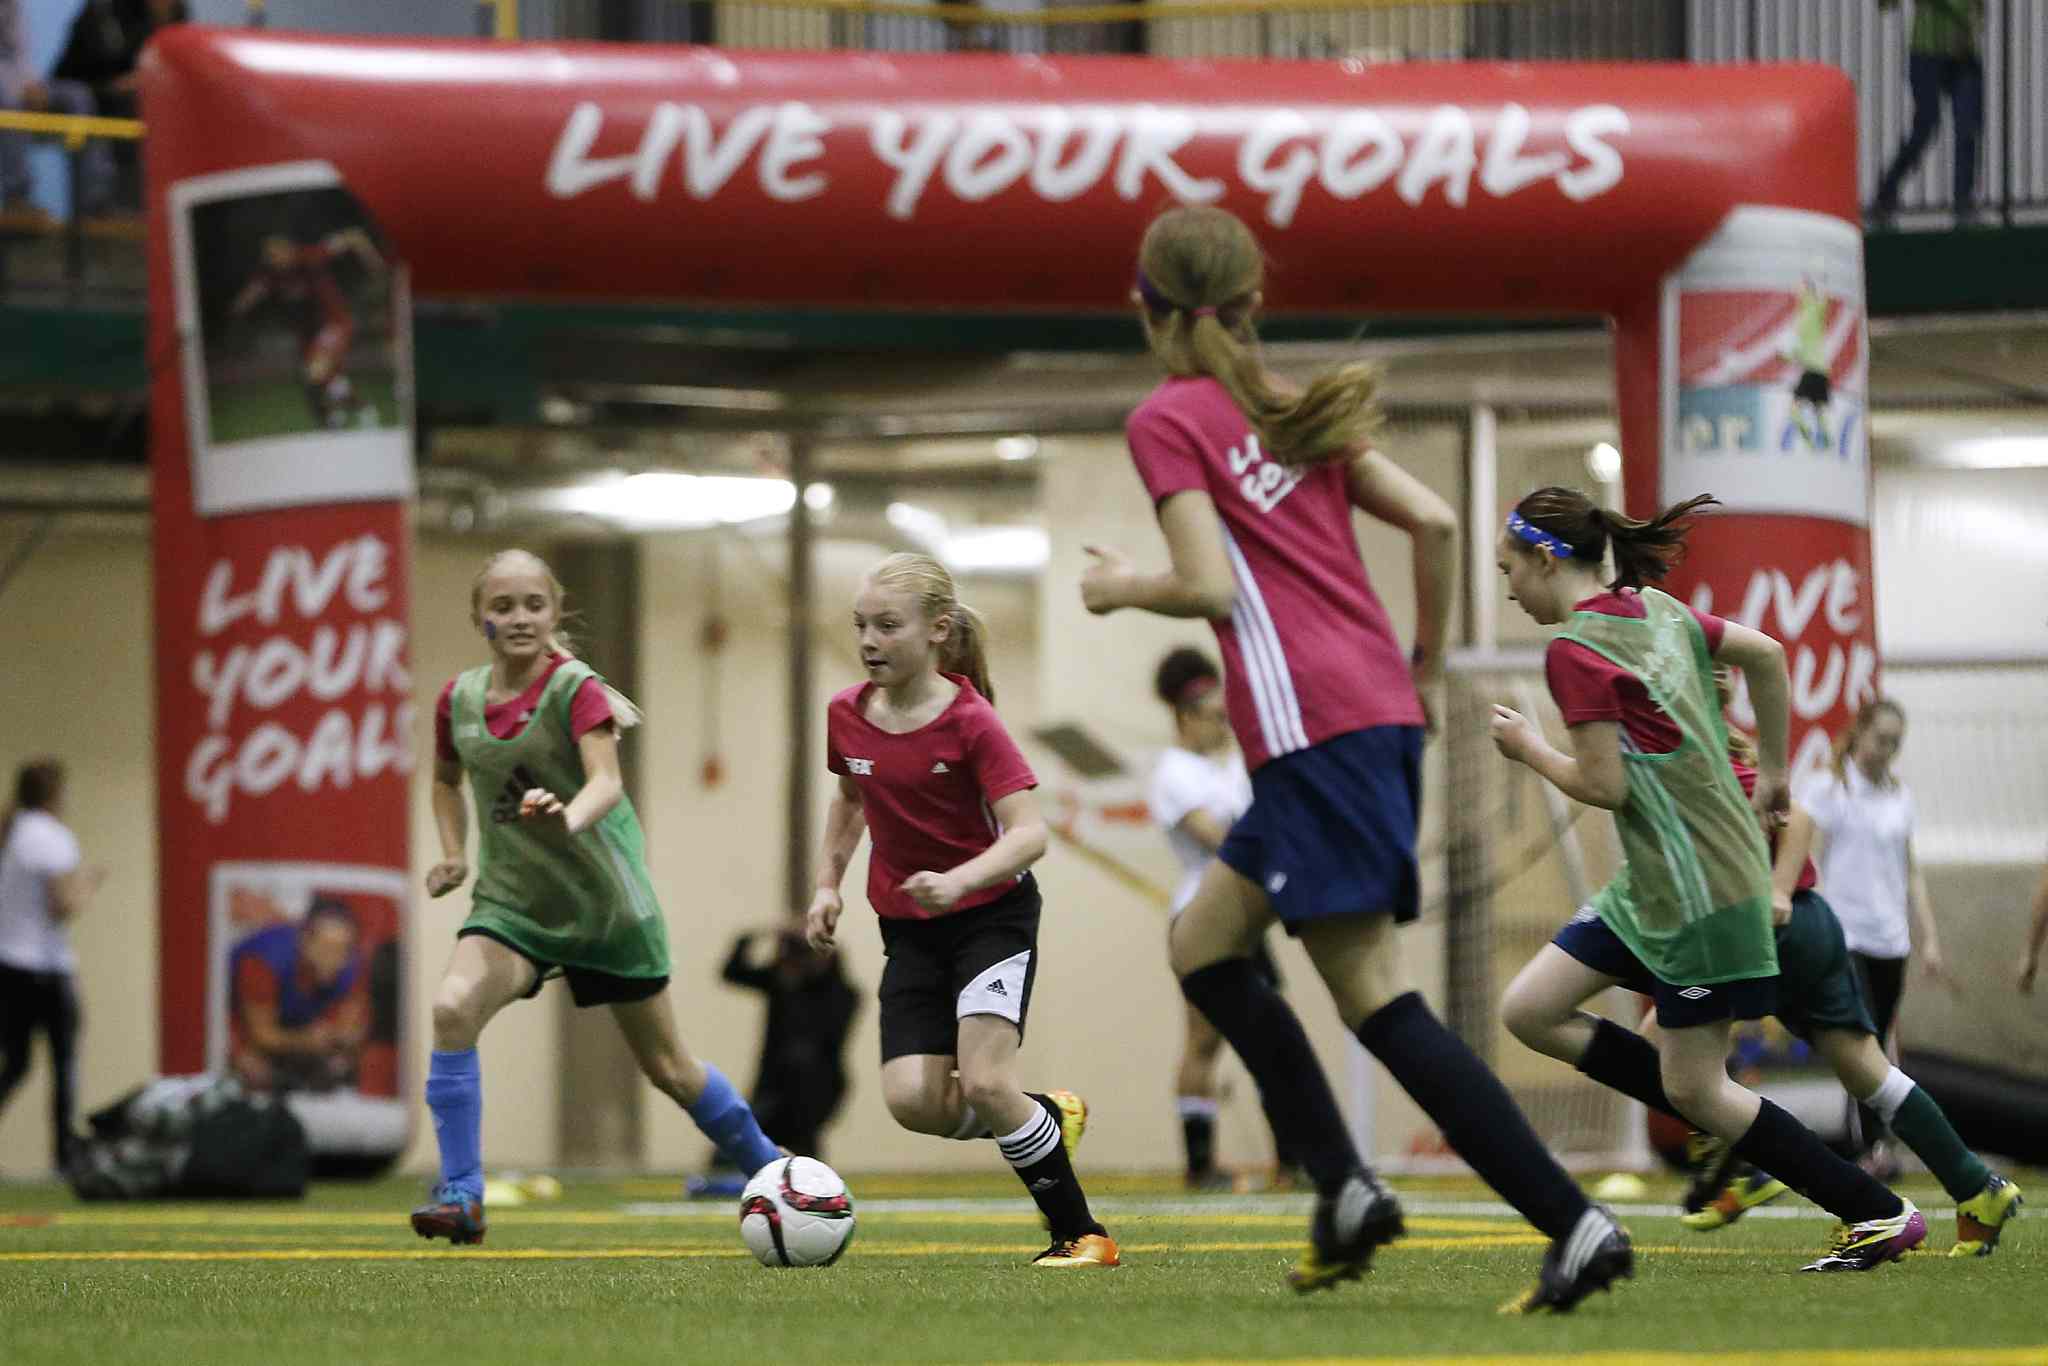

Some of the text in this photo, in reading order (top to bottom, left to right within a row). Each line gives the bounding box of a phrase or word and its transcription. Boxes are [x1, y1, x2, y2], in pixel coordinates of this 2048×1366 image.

[546, 102, 1632, 228] LIVE YOUR GOALS
[198, 533, 391, 637] LIVE
[191, 618, 413, 730] YOUR
